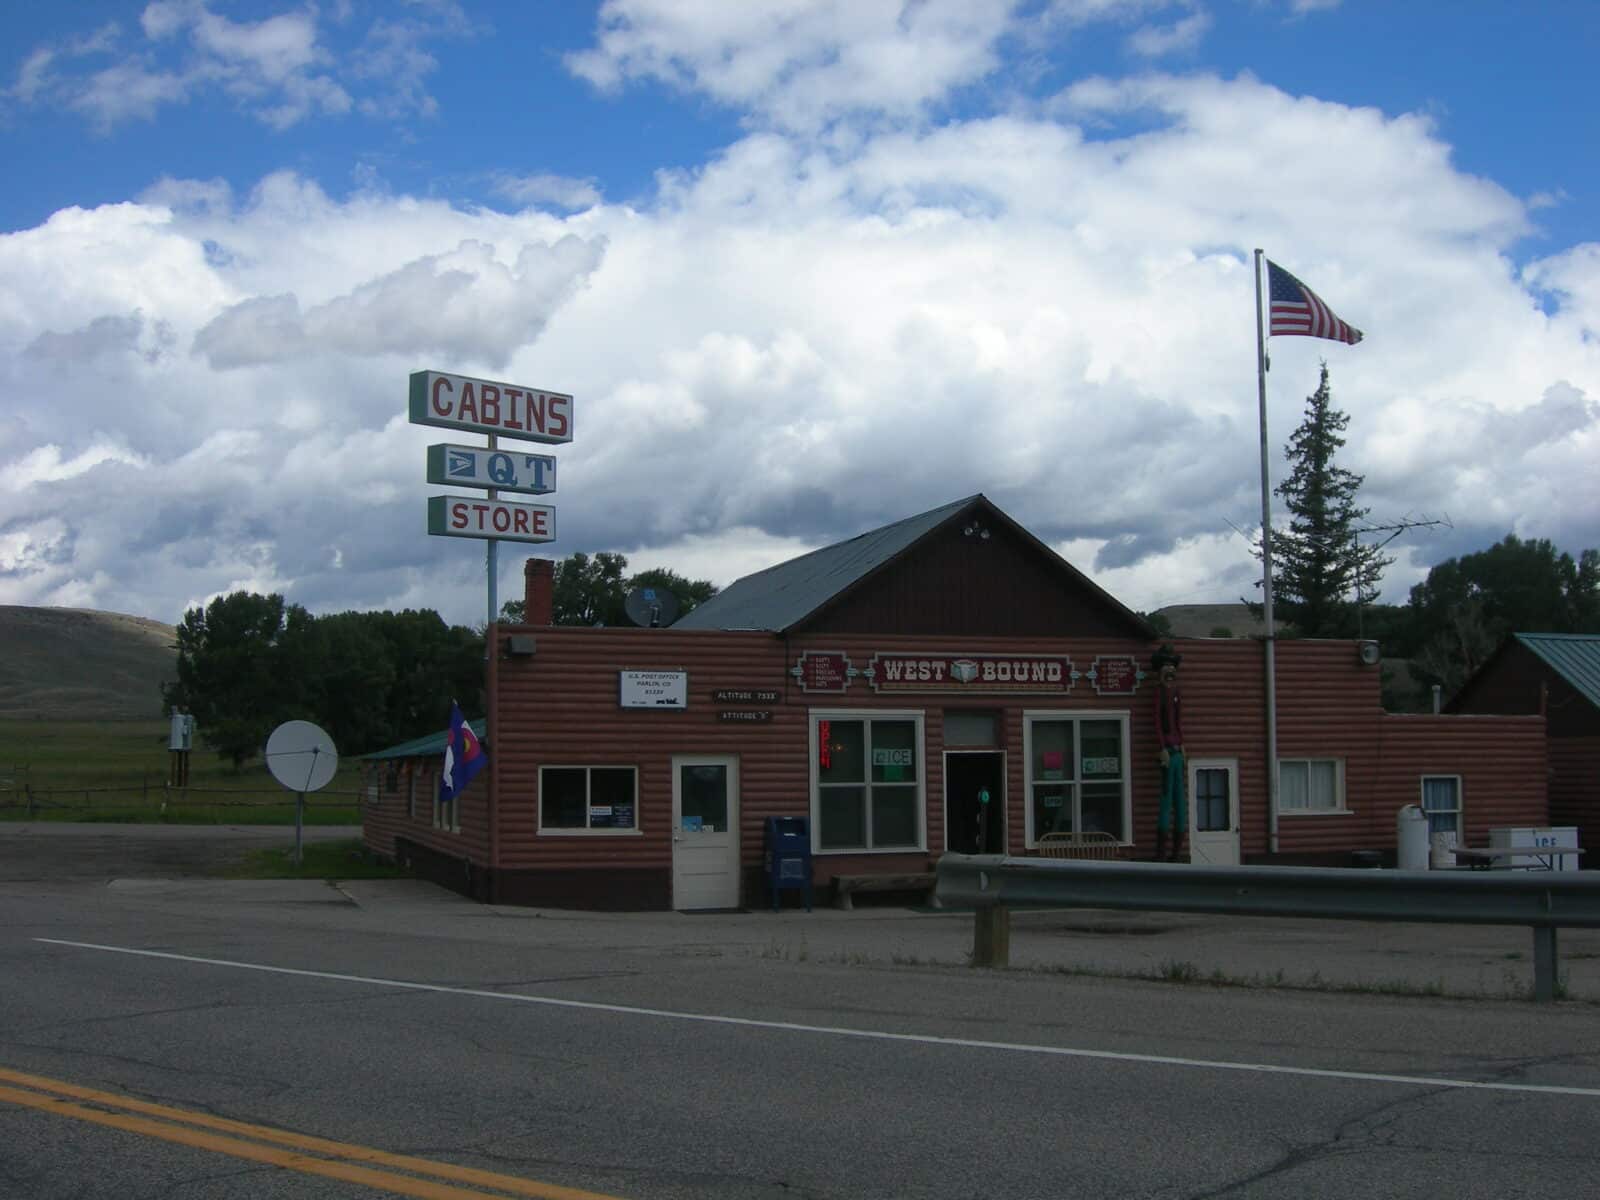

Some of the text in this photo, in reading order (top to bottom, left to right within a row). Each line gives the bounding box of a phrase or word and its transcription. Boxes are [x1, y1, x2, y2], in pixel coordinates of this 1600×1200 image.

[432, 376, 568, 437] CABINS
[452, 503, 548, 535] STORE
[883, 660, 1063, 682] WEST BOUND
